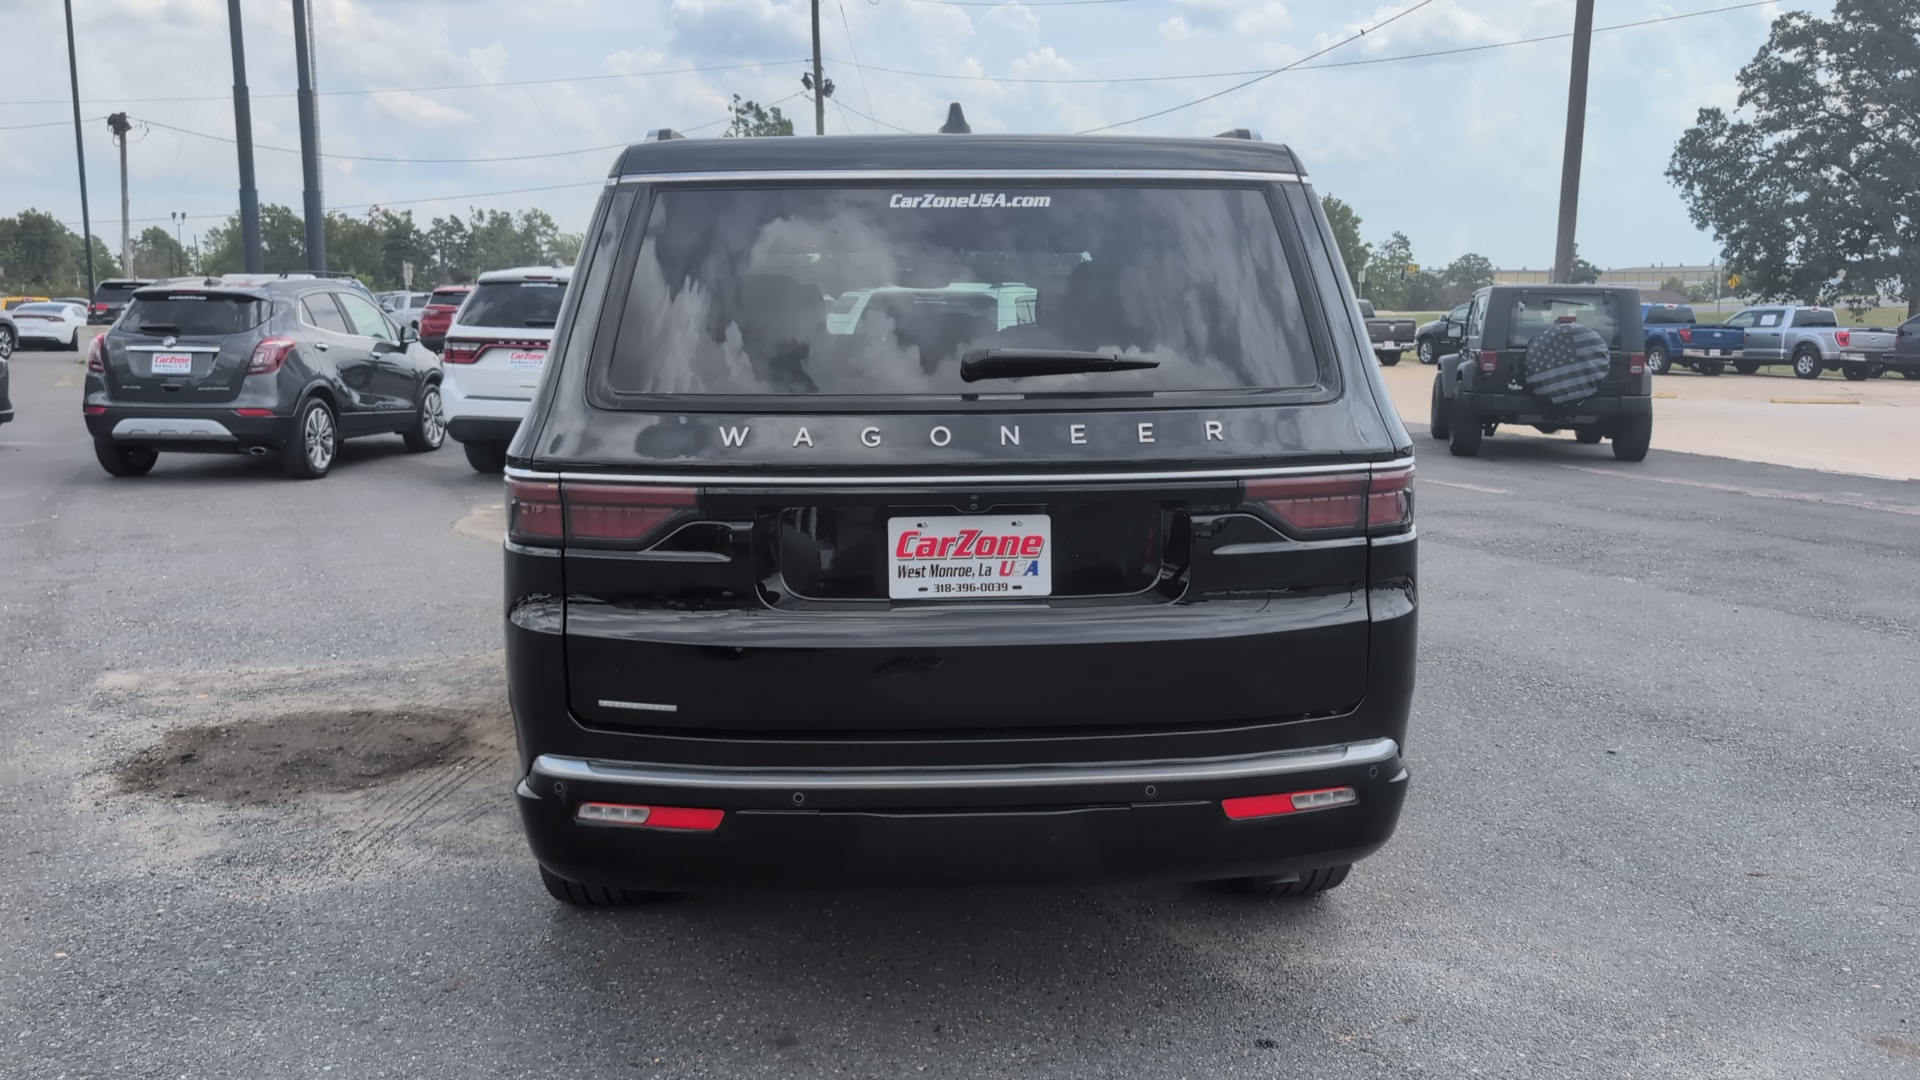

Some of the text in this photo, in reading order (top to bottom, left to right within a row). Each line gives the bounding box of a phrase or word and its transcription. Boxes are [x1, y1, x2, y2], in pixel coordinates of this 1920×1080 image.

[889, 193, 1051, 208] CarZoneUSA.com
[155, 356, 190, 364] CarZone
[719, 421, 1224, 447] WAGONEER
[896, 529, 1045, 560] CarZone
[897, 560, 1039, 580] West Monroe, La USA
[933, 583, 1008, 593] 318-396-0039
